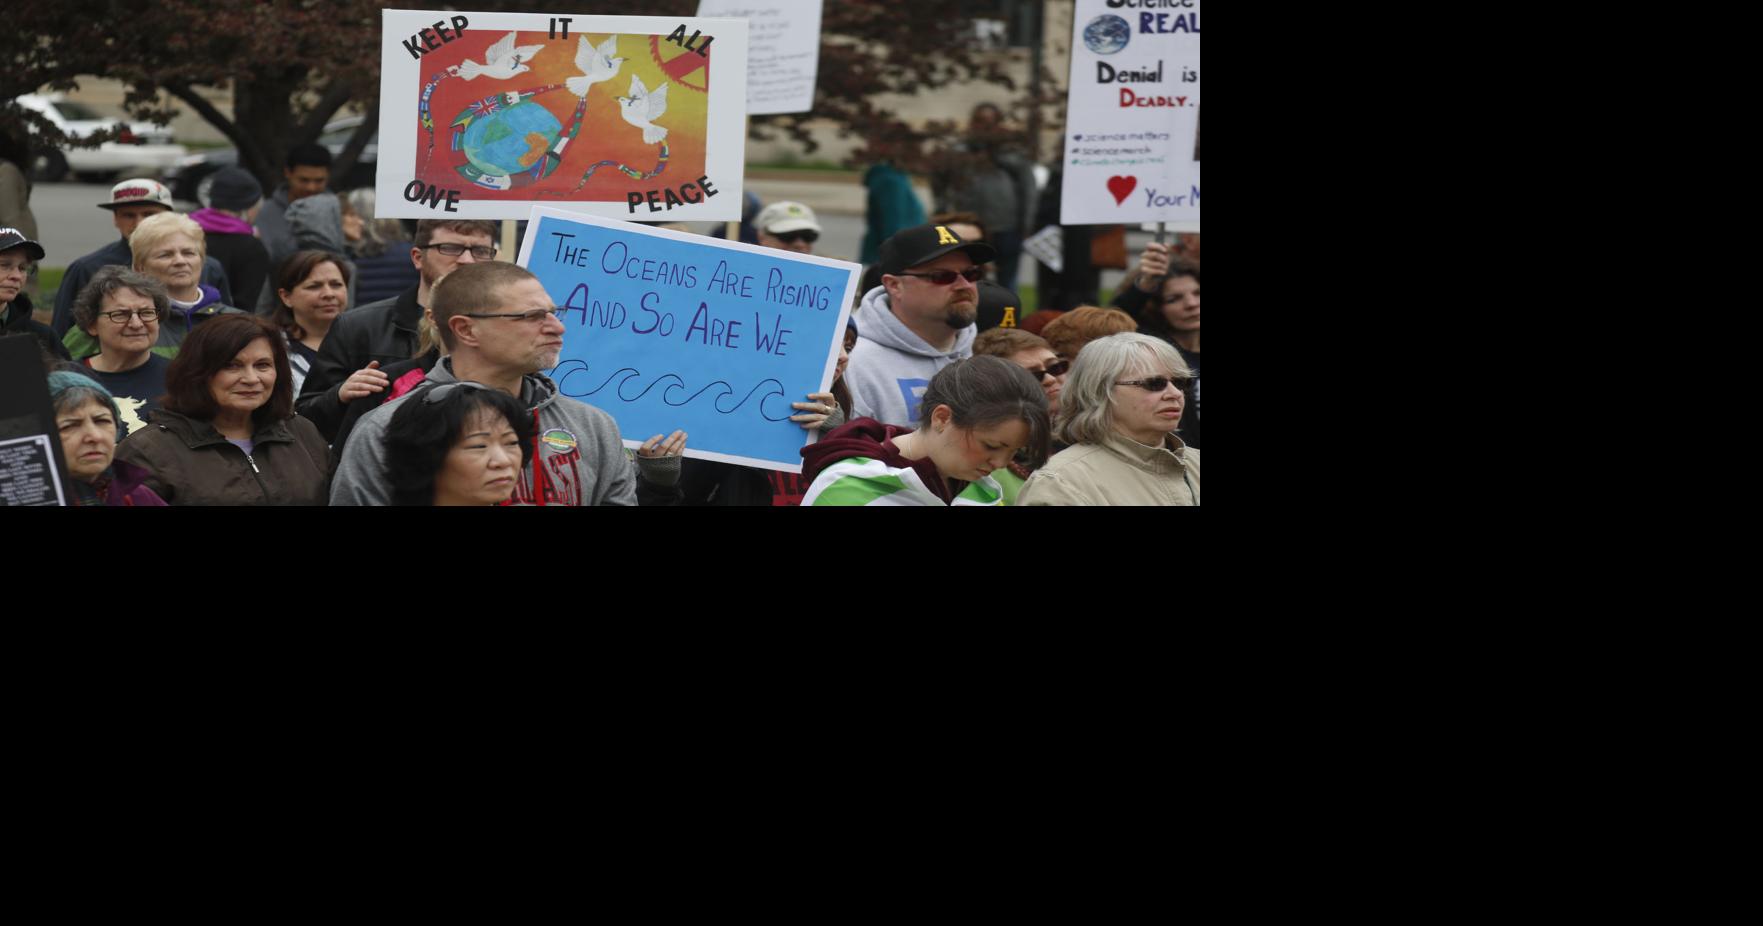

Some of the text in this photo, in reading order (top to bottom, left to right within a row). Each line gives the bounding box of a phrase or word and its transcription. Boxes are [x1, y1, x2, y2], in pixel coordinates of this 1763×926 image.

[1139, 11, 1200, 34] REAL
[402, 15, 715, 60] KEEP IT ALL
[1096, 59, 1198, 84] Denial is
[403, 175, 719, 214] ONE PEACE
[1144, 187, 1187, 208] Your
[935, 226, 959, 245] A
[551, 232, 831, 311] THE OCEANS ARE RISING
[564, 283, 626, 330] AND
[685, 302, 742, 349] ARE
[755, 312, 793, 356] WE
[1000, 307, 1016, 327] A
